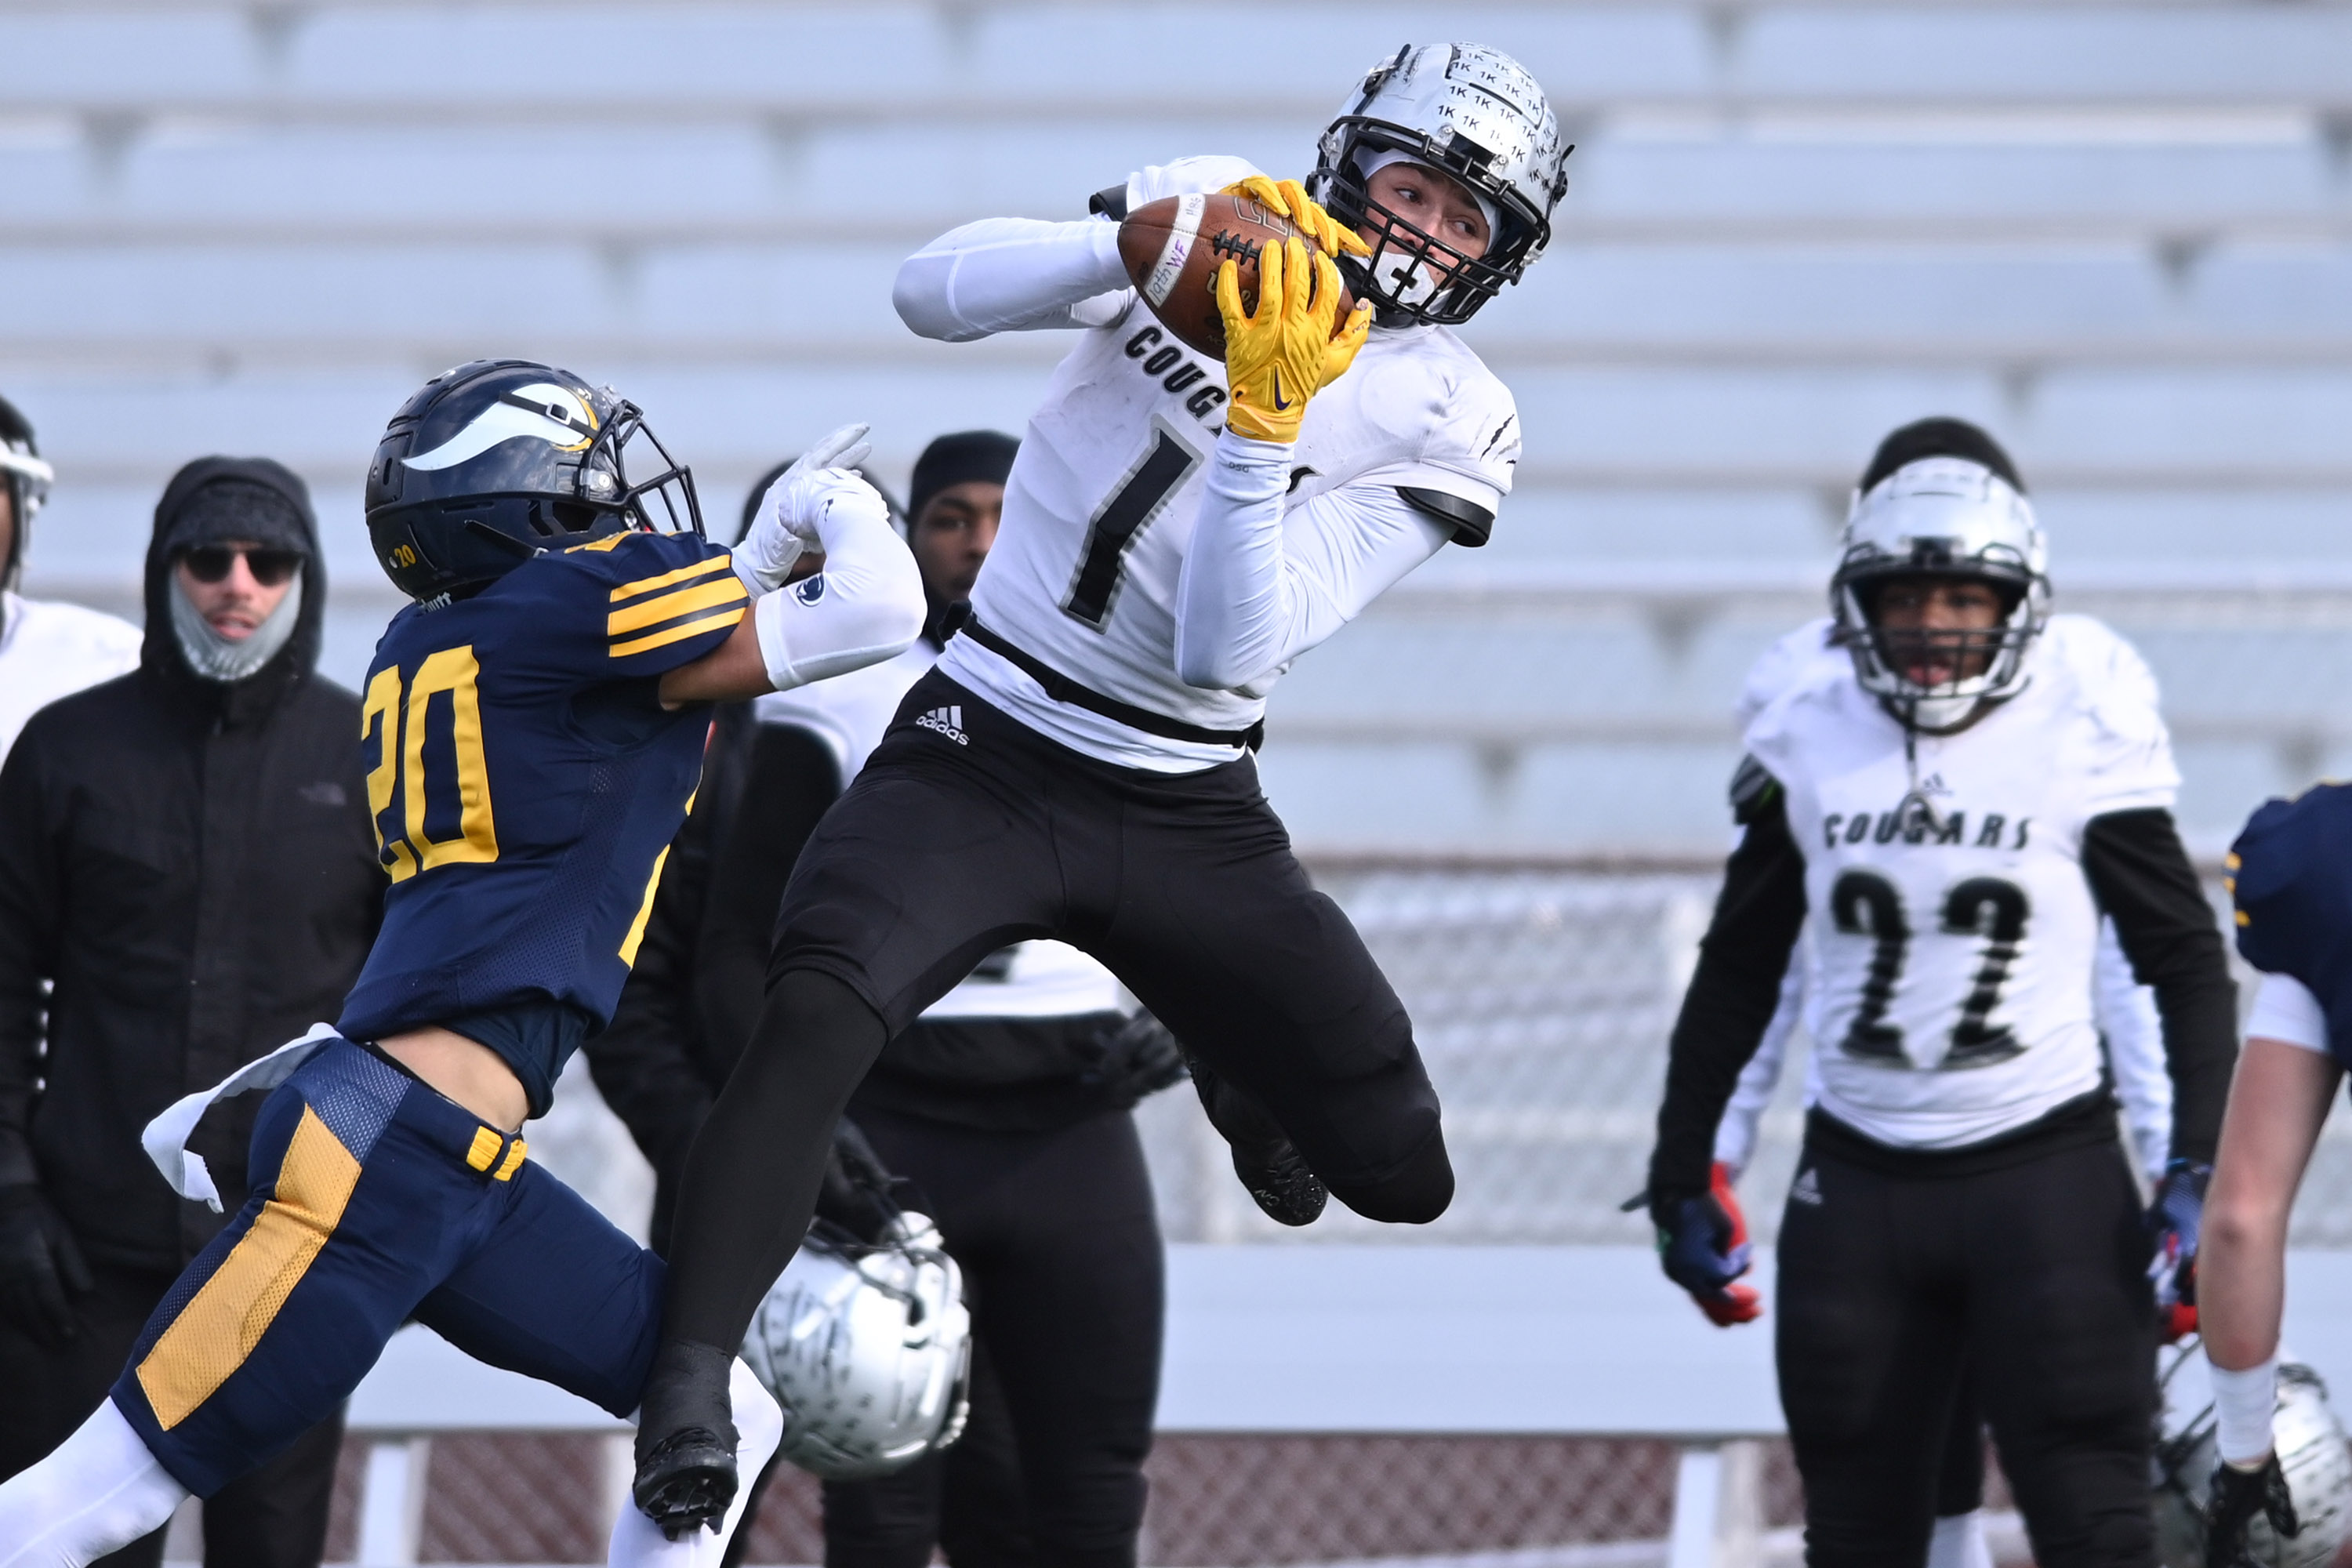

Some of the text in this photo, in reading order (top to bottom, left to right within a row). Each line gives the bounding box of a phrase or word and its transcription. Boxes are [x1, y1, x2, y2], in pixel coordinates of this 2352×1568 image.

[1467, 52, 1484, 62] 1K
[1451, 61, 1472, 72] 1K
[1494, 62, 1510, 74] 1K
[1480, 71, 1497, 84] 1K
[1450, 85, 1468, 98] 1K
[1505, 83, 1520, 98] 1K
[1475, 95, 1491, 110] 1K
[1527, 99, 1539, 116] 1K
[1438, 104, 1456, 119] 1K
[1500, 108, 1515, 124] 1K
[1463, 115, 1480, 131] 1K
[1523, 125, 1536, 143] 1K
[1512, 145, 1526, 163] 1K
[1537, 143, 1547, 159] 1K
[1529, 168, 1540, 183] 1K
[1166, 238, 1187, 268] WF
[1058, 413, 1205, 636] 1
[394, 544, 416, 568] 20
[915, 715, 970, 746] adidas
[361, 644, 499, 884] 20
[1830, 867, 2032, 1070] 22
